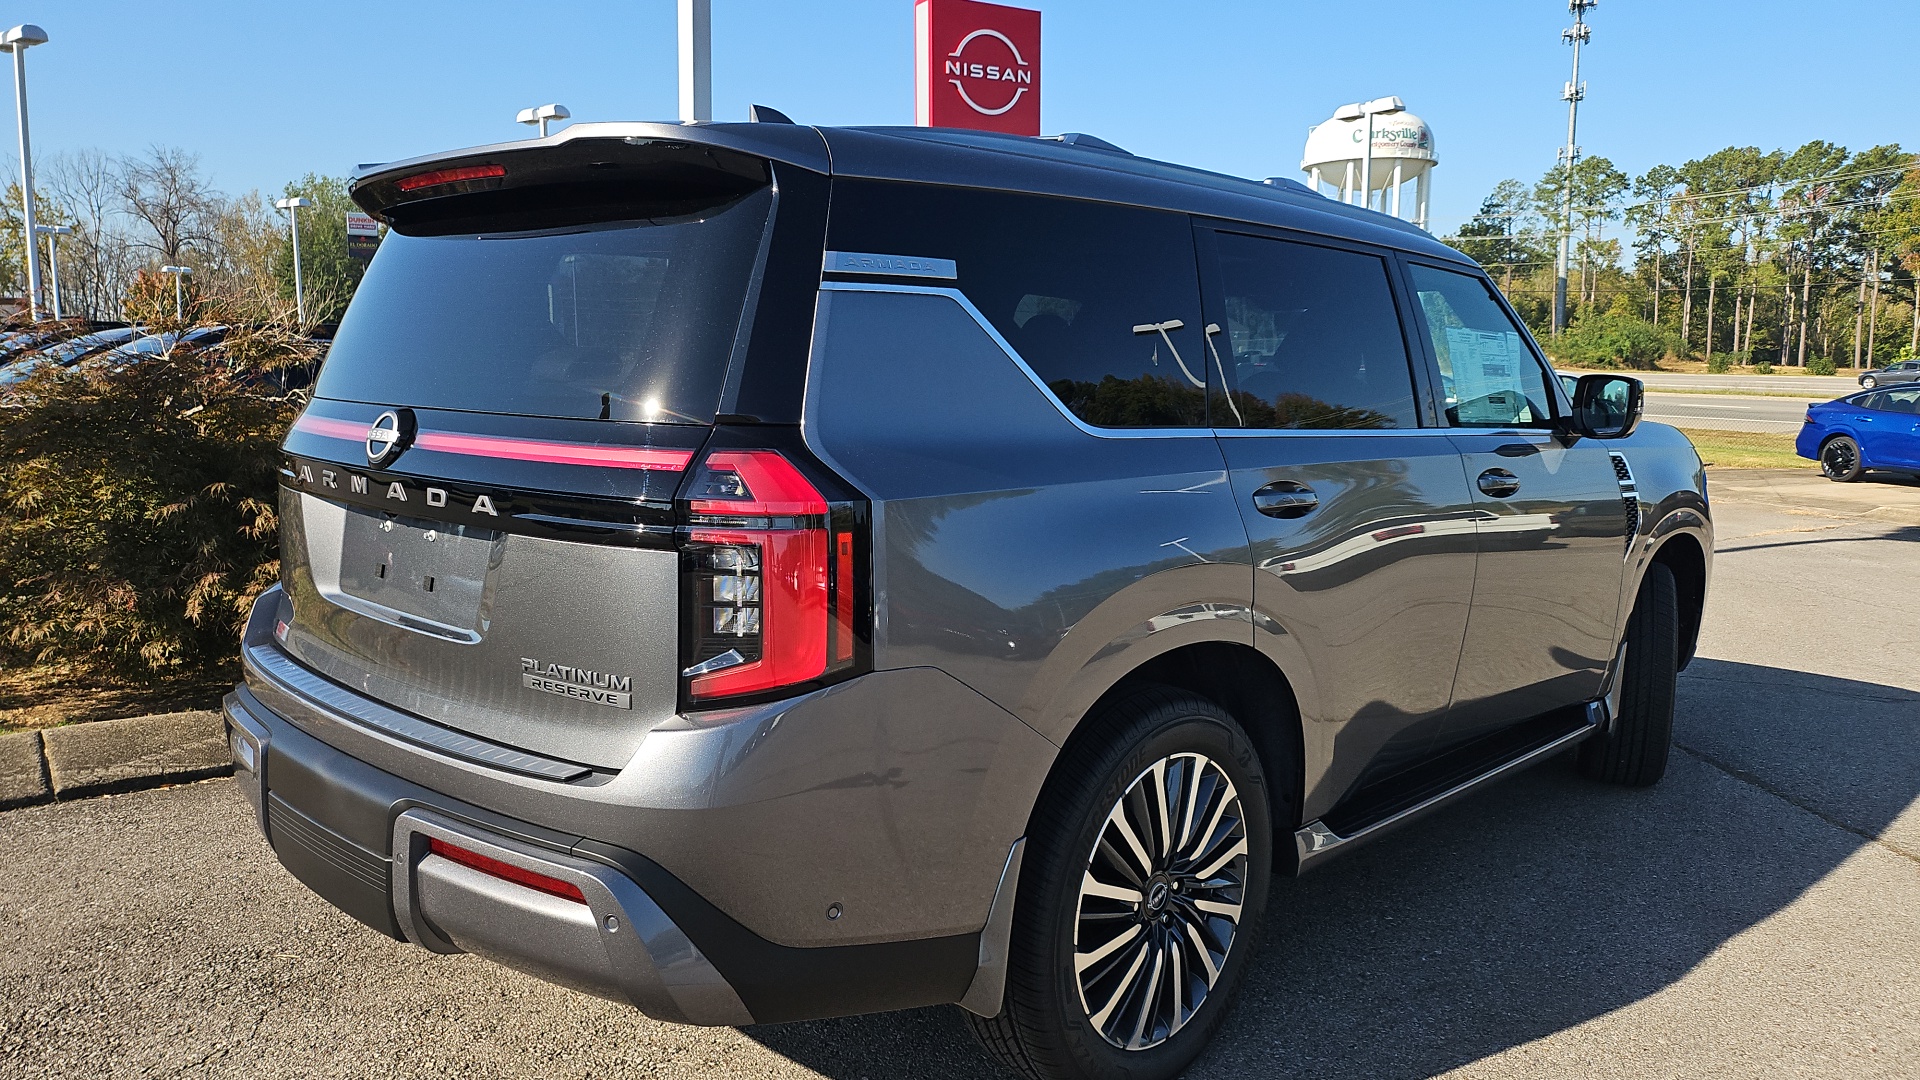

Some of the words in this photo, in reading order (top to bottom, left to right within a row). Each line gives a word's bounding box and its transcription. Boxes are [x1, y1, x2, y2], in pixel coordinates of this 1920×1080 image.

[945, 60, 1031, 84] NISSAN
[1352, 128, 1417, 143] Crksville
[844, 257, 936, 272] ARMADA
[299, 465, 499, 517] ARMADA
[521, 657, 632, 692] PLATINUM
[531, 678, 618, 704] RESERVE
